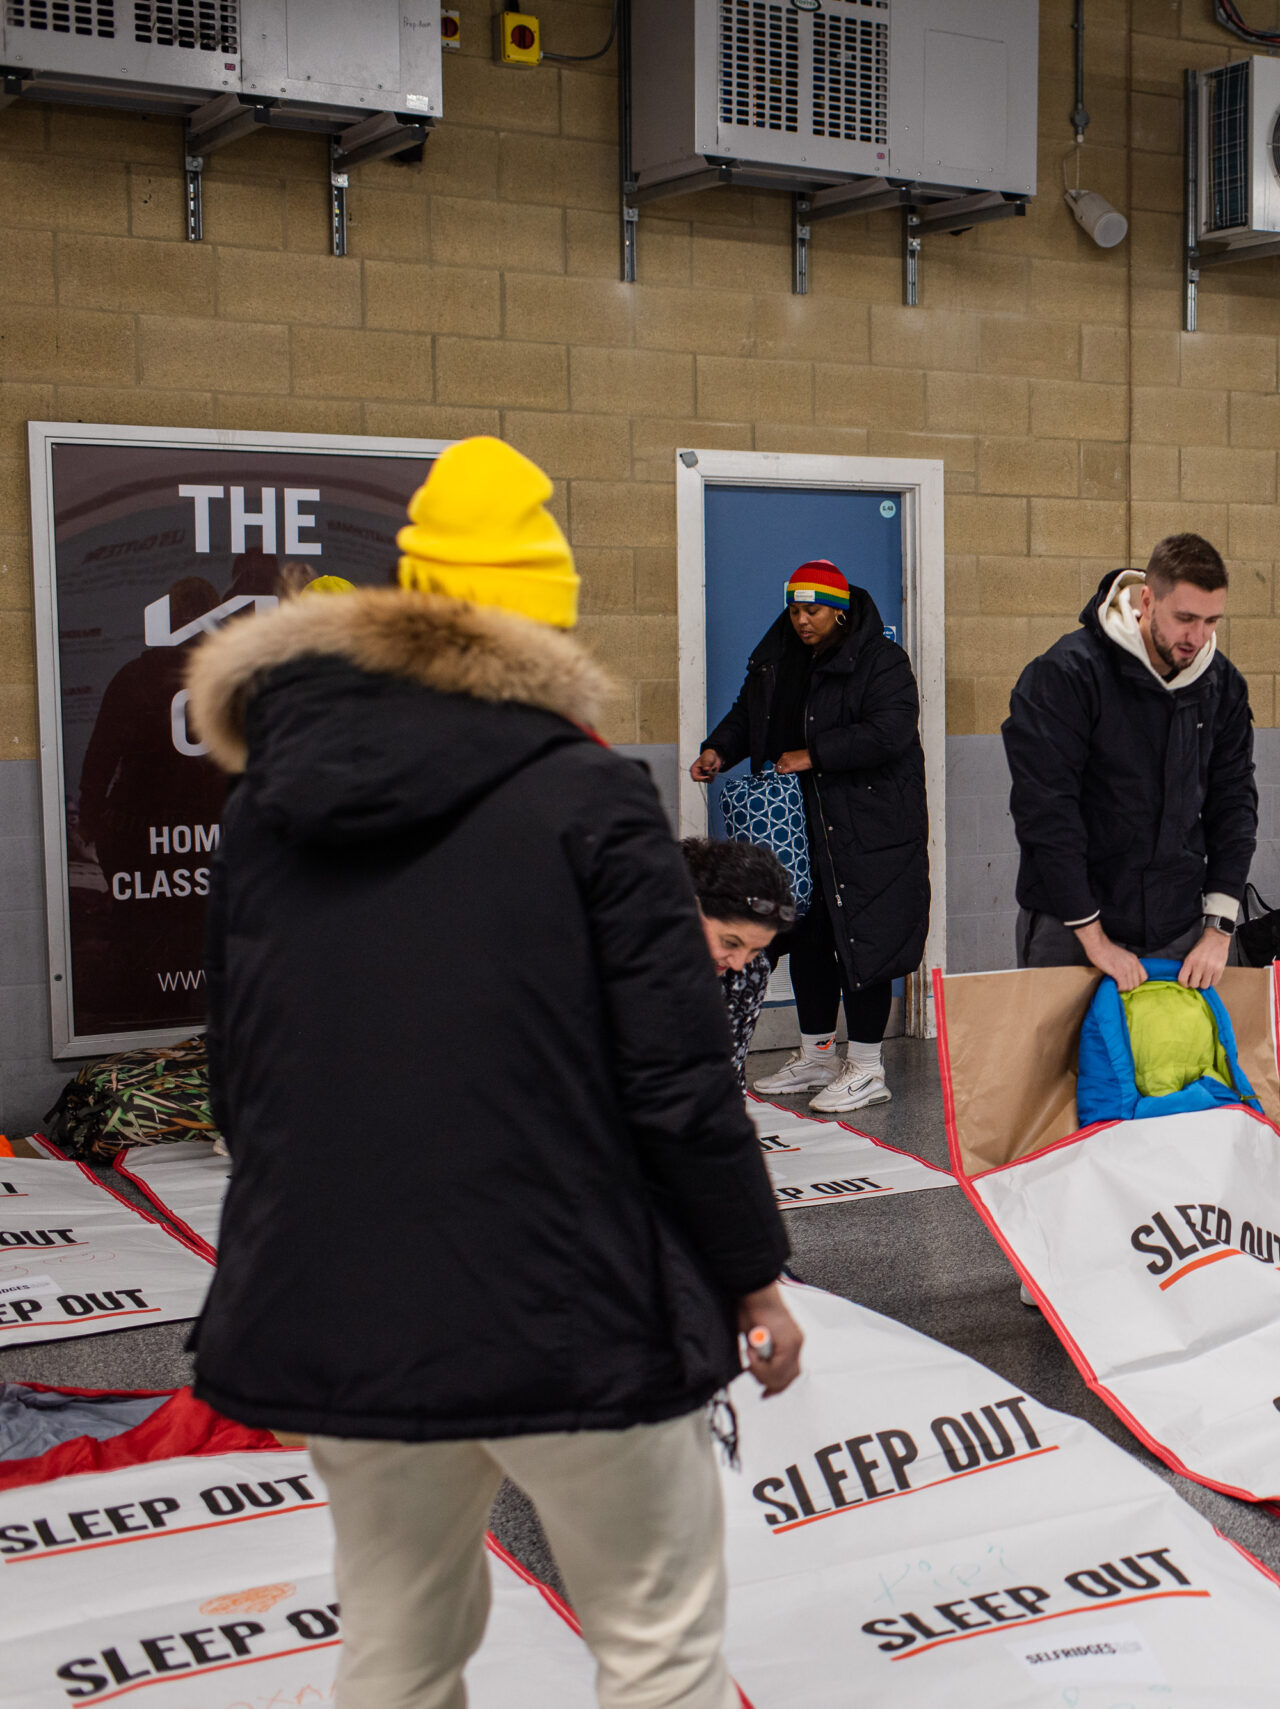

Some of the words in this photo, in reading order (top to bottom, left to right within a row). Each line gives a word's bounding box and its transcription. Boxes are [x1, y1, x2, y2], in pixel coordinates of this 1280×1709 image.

[178, 484, 322, 555] THE
[150, 824, 220, 855] HOM
[157, 969, 207, 992] WW
[810, 1177, 883, 1195] OUT
[0, 1229, 78, 1246] OUT
[57, 1289, 149, 1316] OUT
[752, 1429, 919, 1525] SLEEP
[930, 1396, 1042, 1473] OUT
[0, 1497, 180, 1554] SLEEP
[200, 1474, 315, 1516] OUT
[861, 1585, 1051, 1651] SLEEP
[1064, 1547, 1192, 1598] OUT
[57, 1621, 265, 1697] SLEEP
[1026, 1642, 1116, 1664] SELFRIDGES
